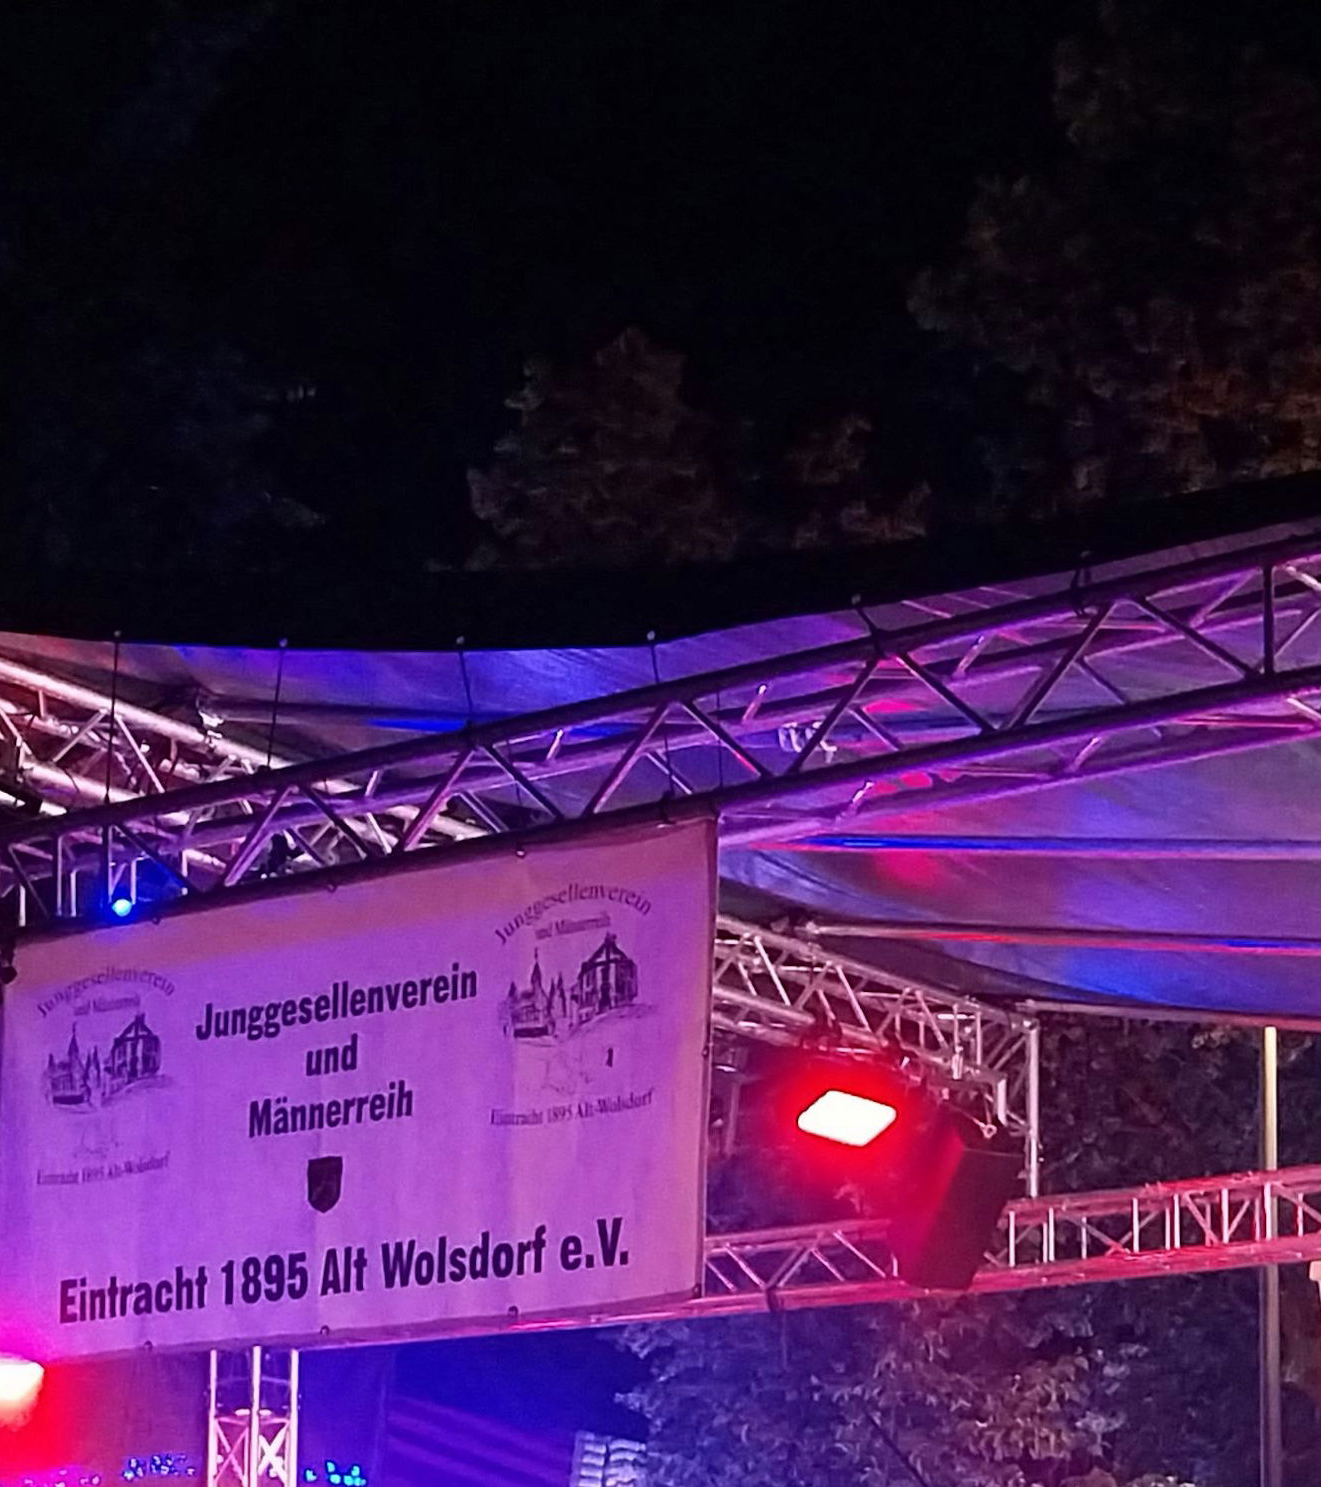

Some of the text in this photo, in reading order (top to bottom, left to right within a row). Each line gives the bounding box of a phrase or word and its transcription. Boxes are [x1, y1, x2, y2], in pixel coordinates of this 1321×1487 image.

[196, 962, 477, 1041] Junggesellenverein
[306, 1033, 358, 1077] und
[249, 1079, 413, 1138] Männerreih
[60, 1217, 628, 1324] Eintracht 1895 Alt Wolsdorf e.V.
